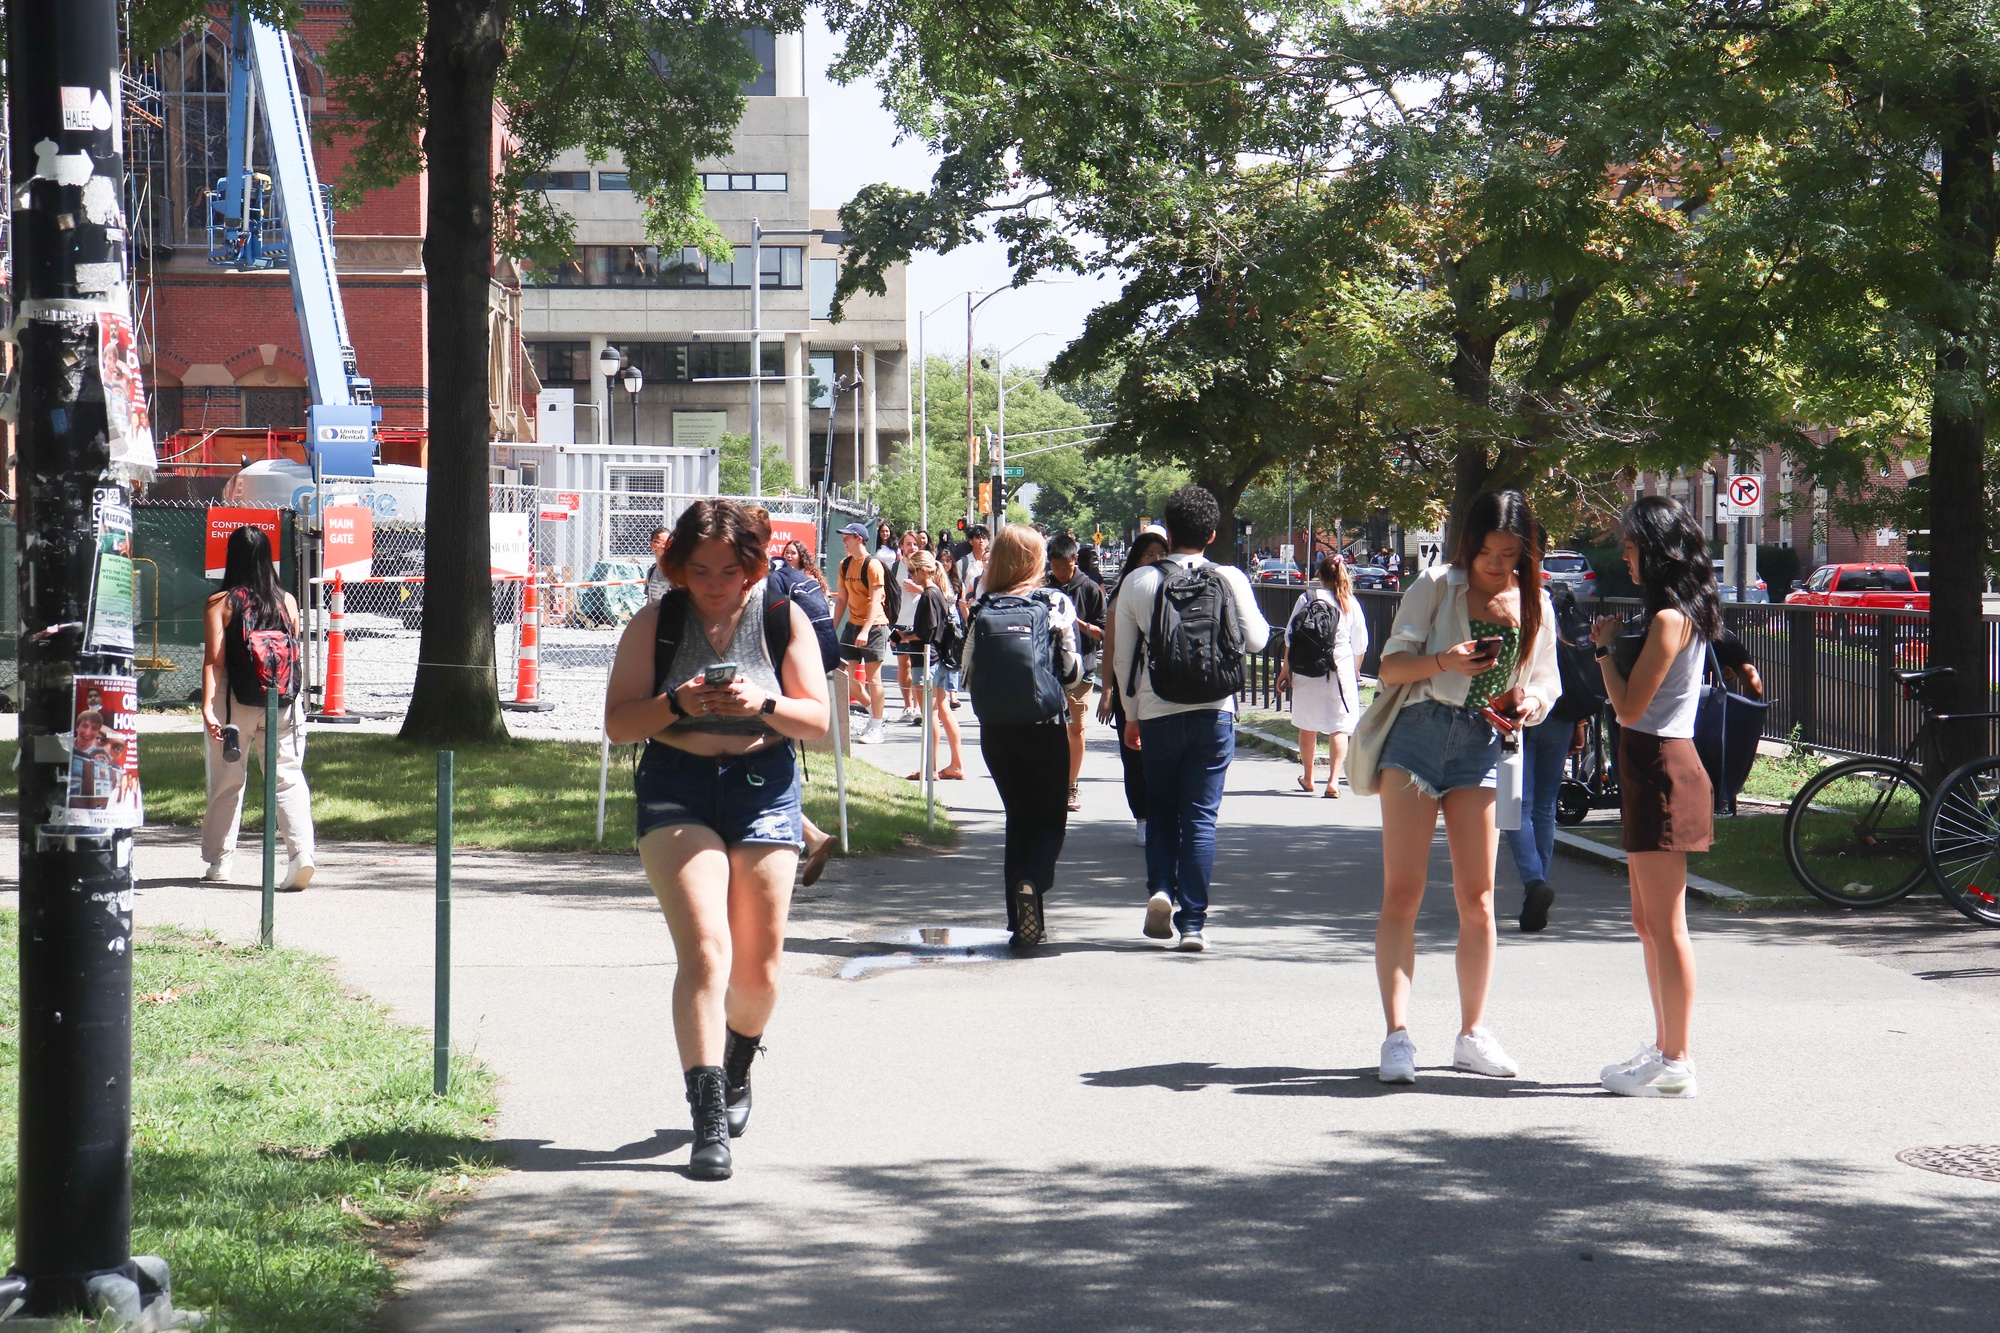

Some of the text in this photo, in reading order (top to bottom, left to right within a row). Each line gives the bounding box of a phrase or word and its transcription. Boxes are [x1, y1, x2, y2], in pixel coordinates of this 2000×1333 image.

[329, 518, 354, 529] MAIN
[329, 534, 354, 544] GATE
[770, 531, 791, 540] AIN
